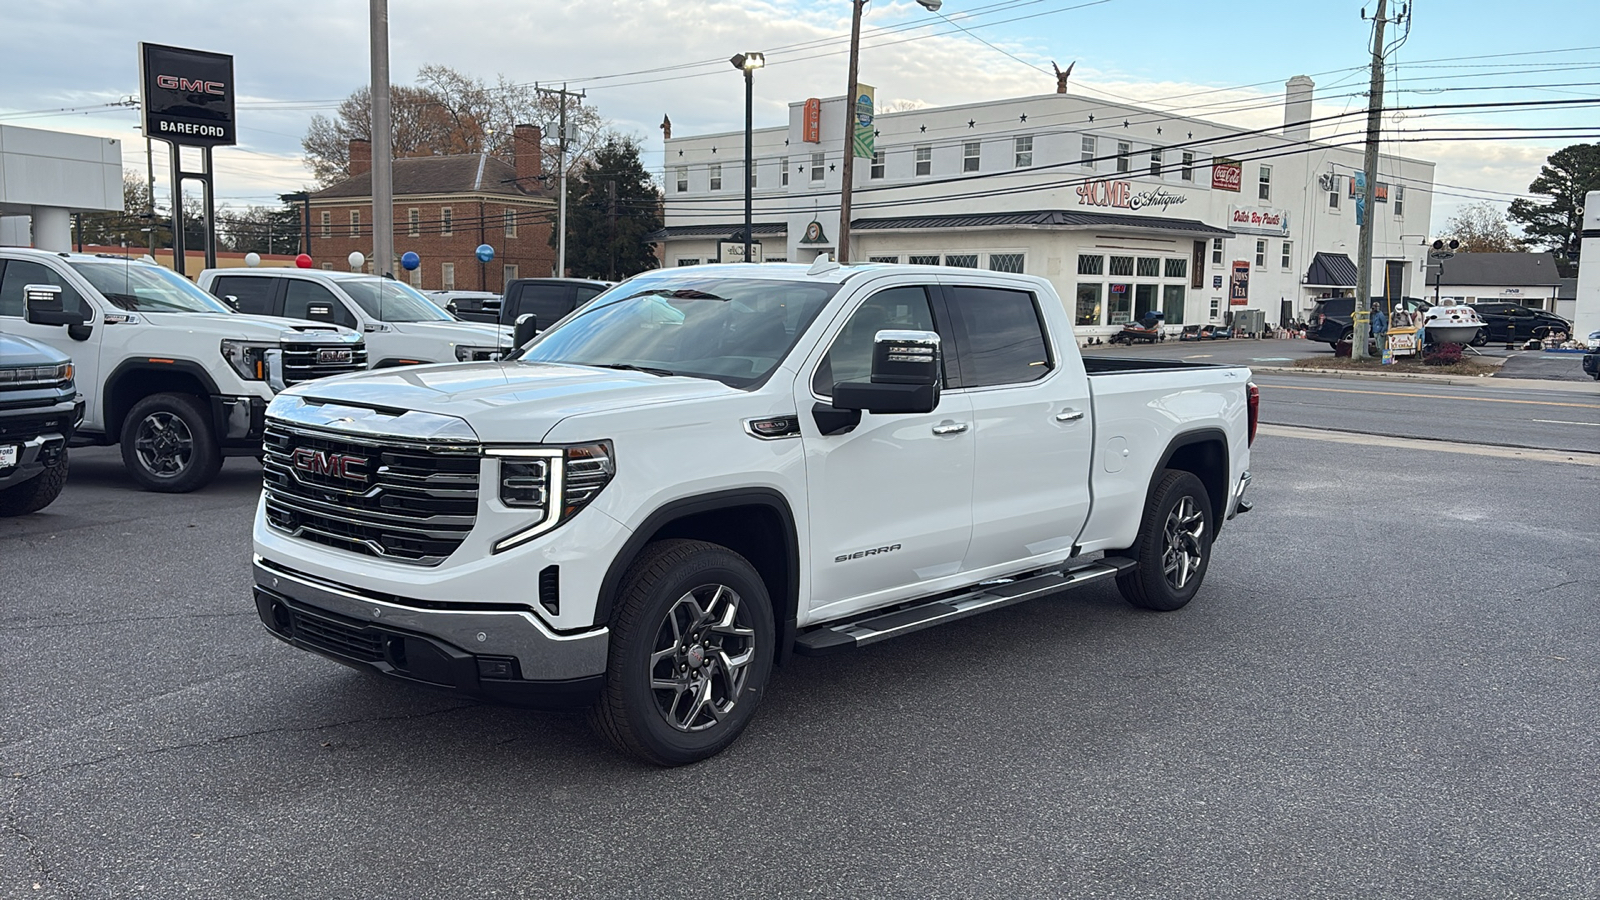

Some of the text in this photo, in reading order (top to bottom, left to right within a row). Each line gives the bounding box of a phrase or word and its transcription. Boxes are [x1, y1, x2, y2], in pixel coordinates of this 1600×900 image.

[157, 75, 225, 95] GMC
[160, 121, 224, 137] BAREFORD
[1076, 178, 1188, 212] ACME Antiques
[1233, 210, 1280, 226] Dutch Boy Paints
[1234, 286, 1246, 297] TEA
[293, 447, 369, 483] GMC
[834, 543, 902, 563] SIERRA
